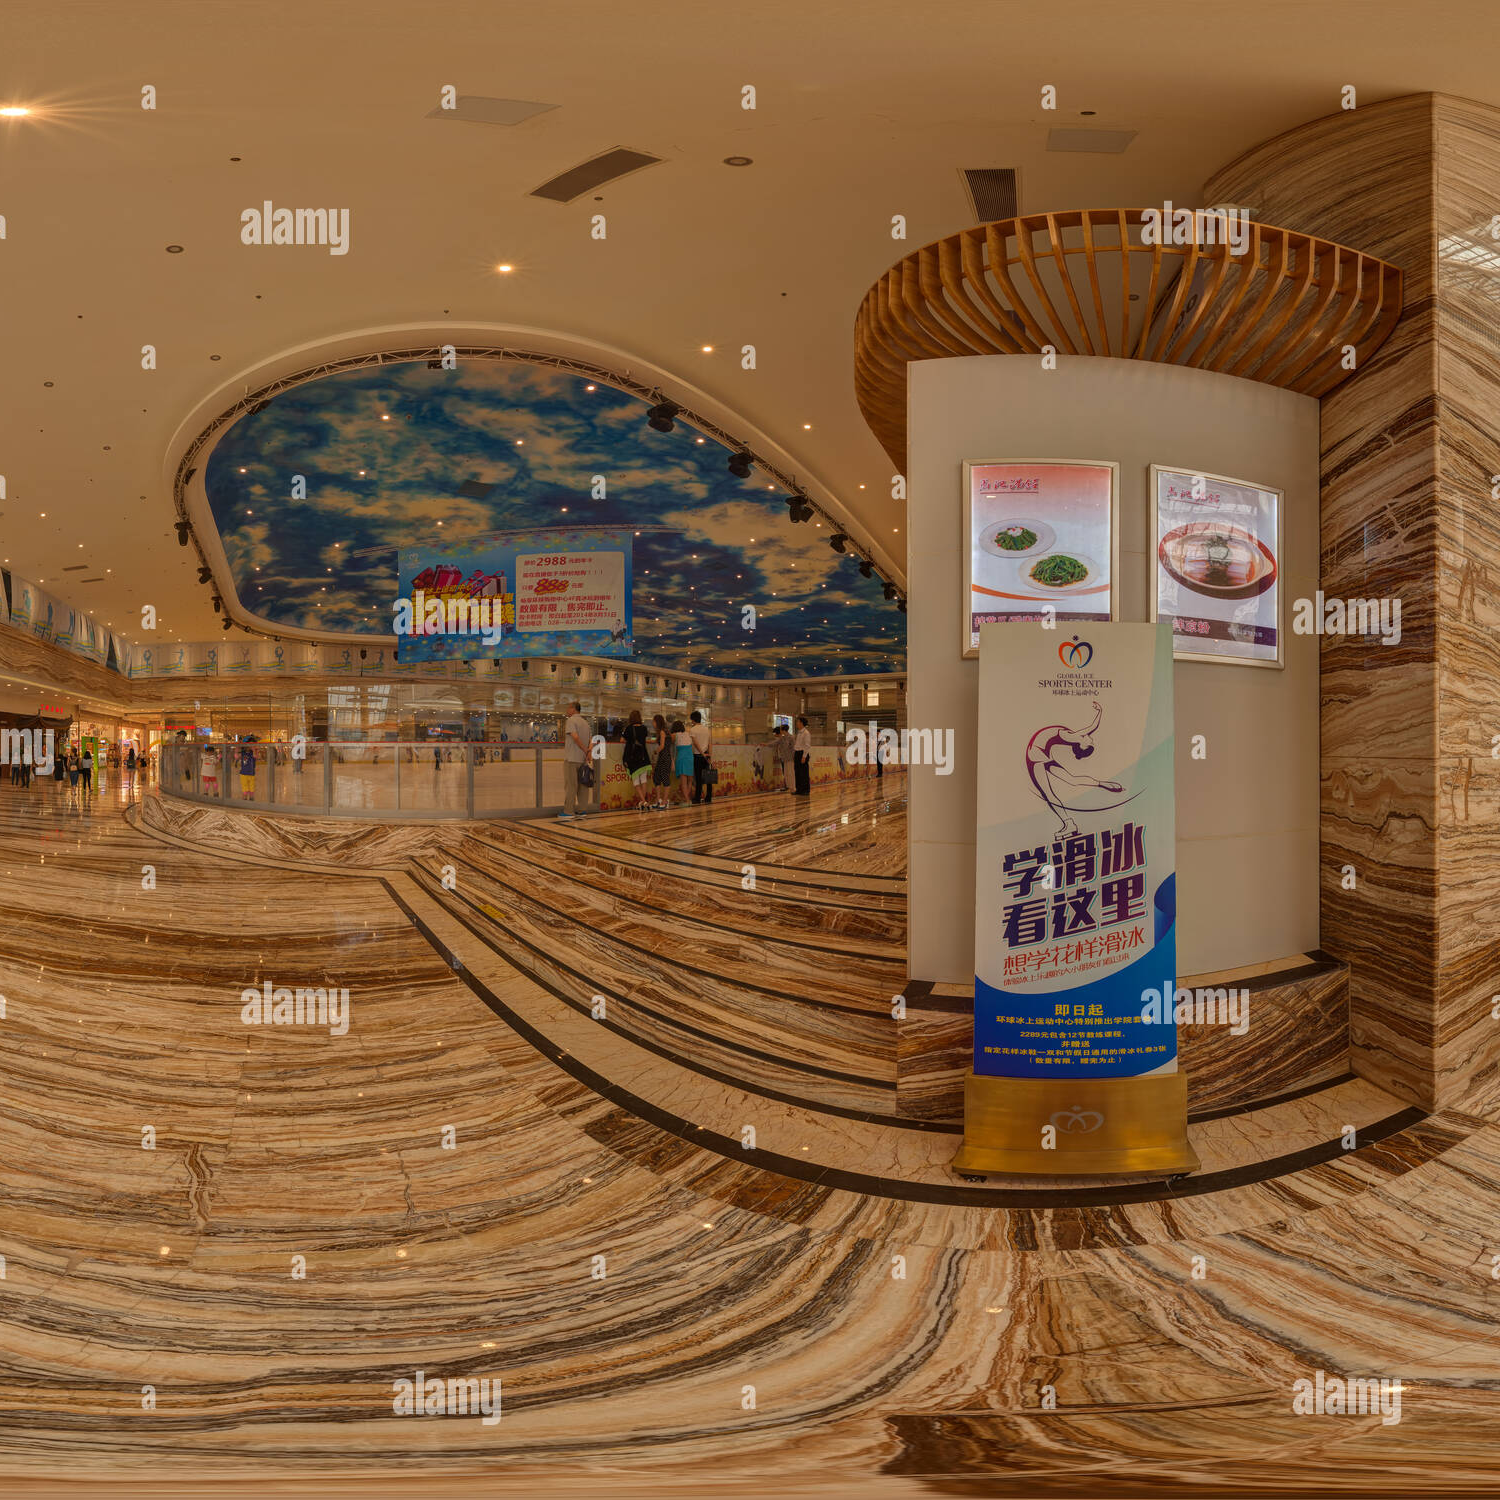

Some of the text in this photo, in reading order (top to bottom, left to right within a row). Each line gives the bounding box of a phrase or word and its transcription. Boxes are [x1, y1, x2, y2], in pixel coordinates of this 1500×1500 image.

[536, 557, 567, 566] 2988
[534, 578, 569, 596] 888
[1038, 680, 1112, 688] SPORTS CENTER
[1003, 822, 1146, 898] 学滑冰
[1002, 872, 1146, 947] 看这里
[1003, 926, 1145, 976] 想学花样滑冰
[1054, 1004, 1104, 1016] 即日起
[1061, 1040, 1091, 1048] 并赠送
